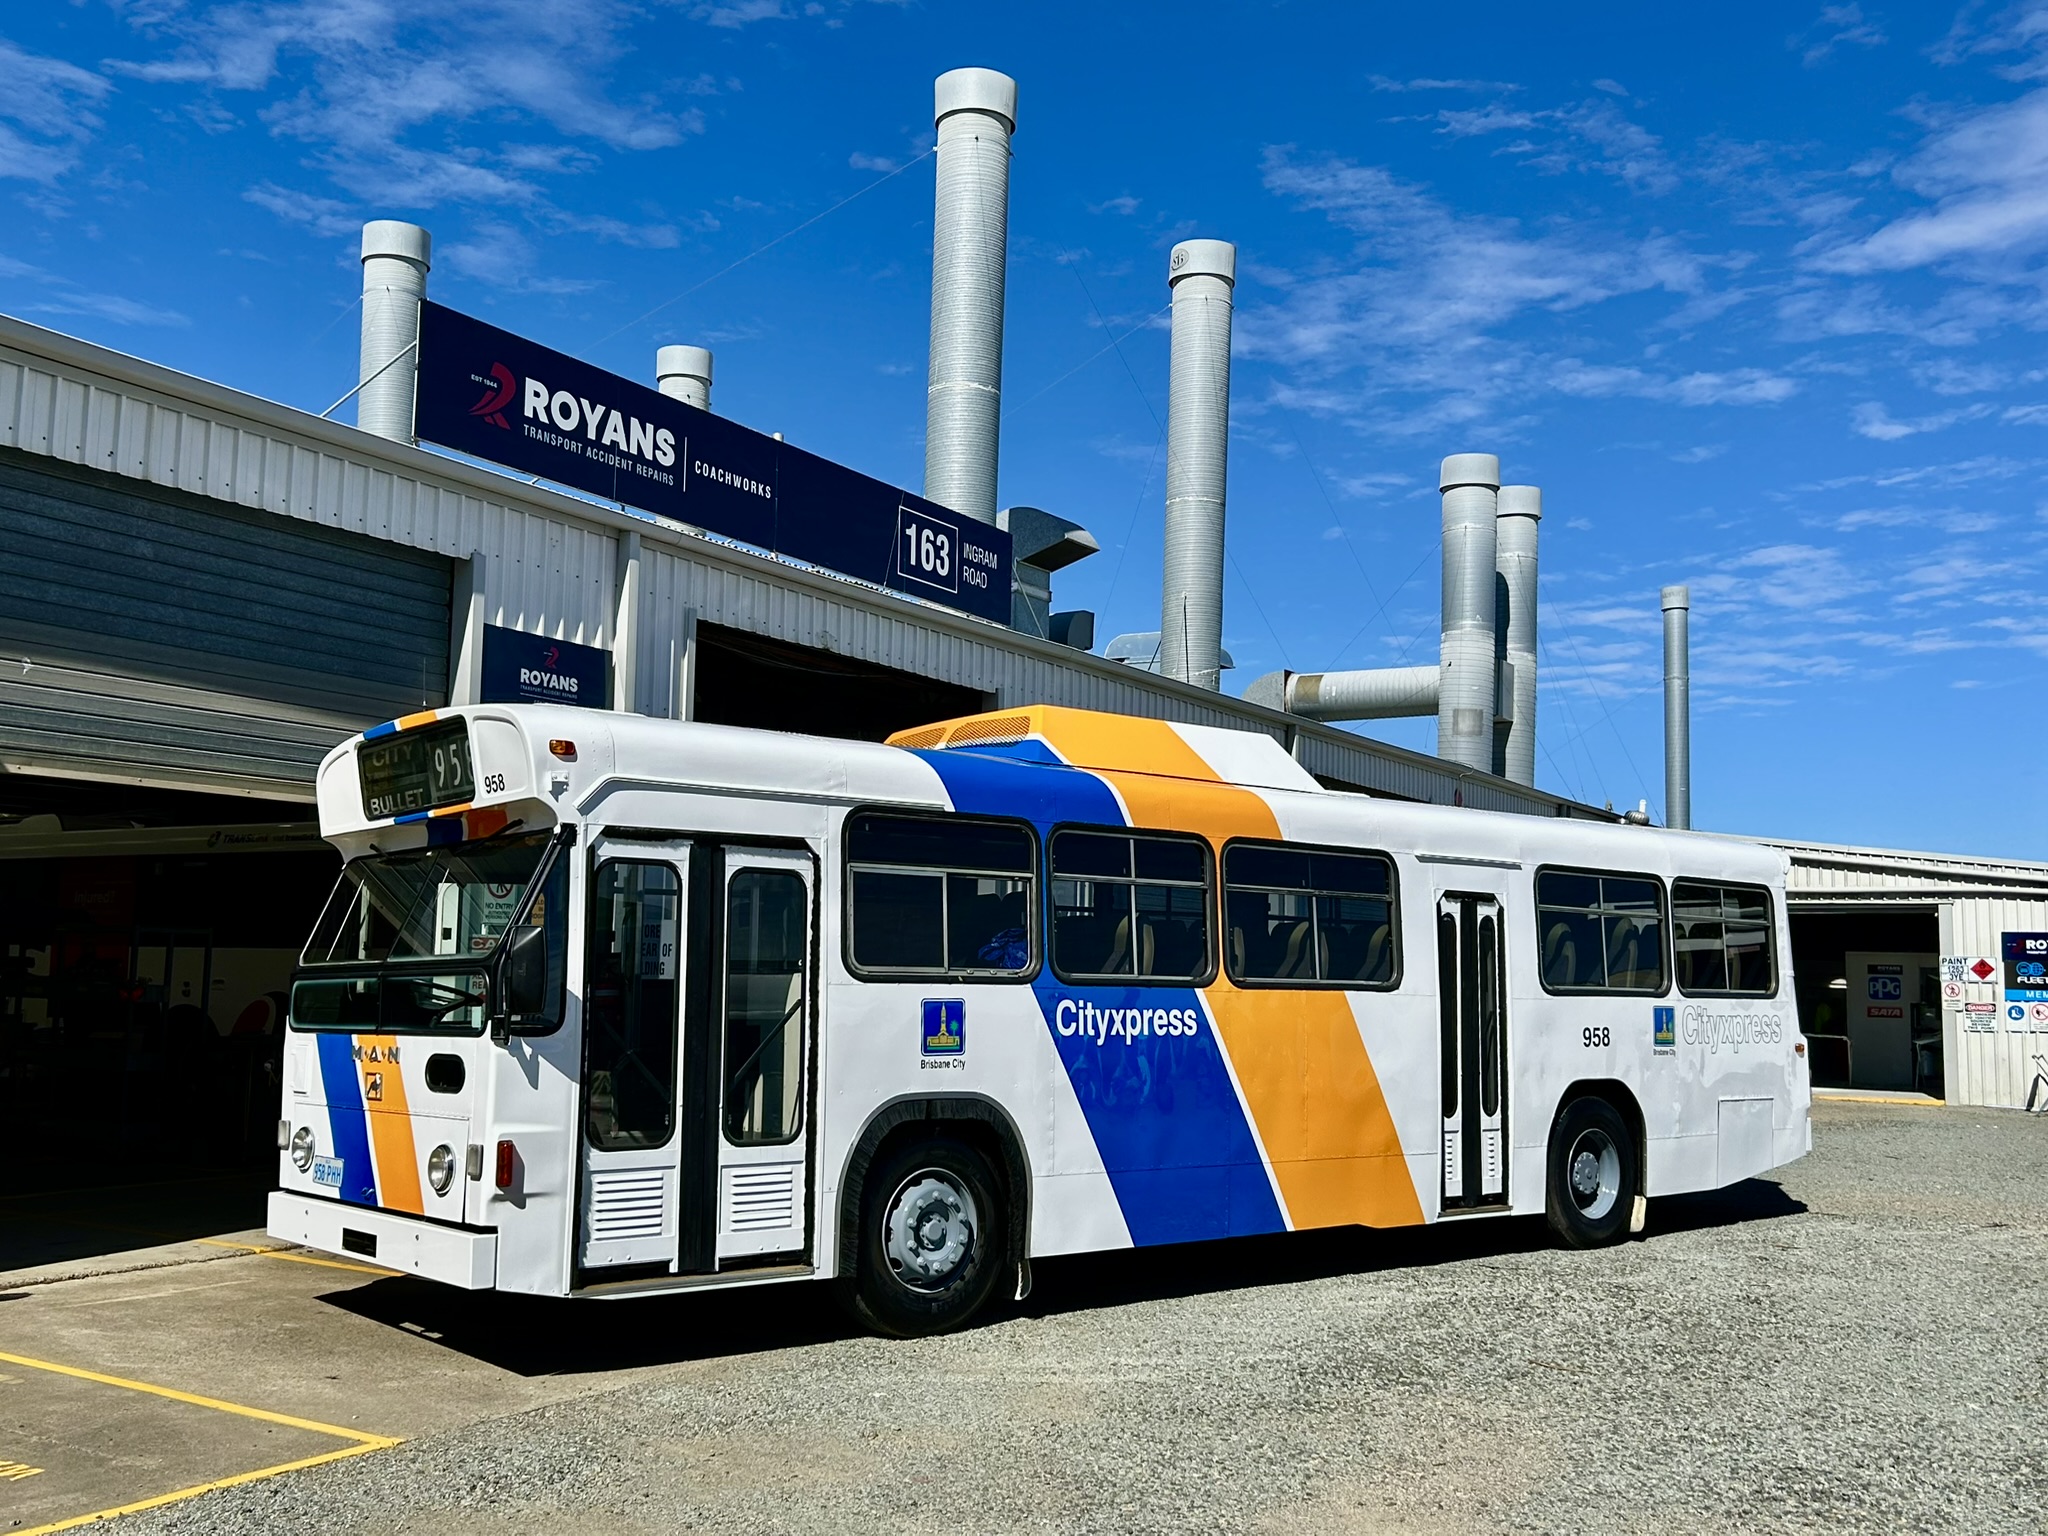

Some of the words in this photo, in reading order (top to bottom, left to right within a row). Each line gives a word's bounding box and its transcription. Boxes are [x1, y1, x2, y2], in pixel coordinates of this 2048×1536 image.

[471, 374, 483, 383] EST
[484, 379, 497, 389] 1944
[524, 376, 675, 467] ROYANS
[523, 423, 583, 455] TRANSPORT
[586, 446, 633, 472] ACCIDENT
[636, 463, 674, 486] REPAIRS
[694, 460, 772, 499] COACHWORKS
[905, 523, 950, 577] 163
[963, 541, 998, 570] INGRAM
[963, 565, 988, 589] ROAD
[520, 668, 578, 693] ROYANS
[372, 741, 414, 767] CITY
[484, 773, 505, 794] 958
[370, 788, 424, 815] BULLET
[495, 903, 514, 911] ENTRY
[662, 943, 673, 957] OF
[1942, 957, 1968, 965] PAINT
[1869, 978, 1900, 999] PPG
[1056, 999, 1198, 1047] Cityxpress
[1870, 1008, 1901, 1017] SATA
[1582, 1026, 1611, 1048] 958
[1682, 1004, 1782, 1056] Cityxpress
[921, 1059, 951, 1069] Brisbane
[952, 1058, 966, 1071] City
